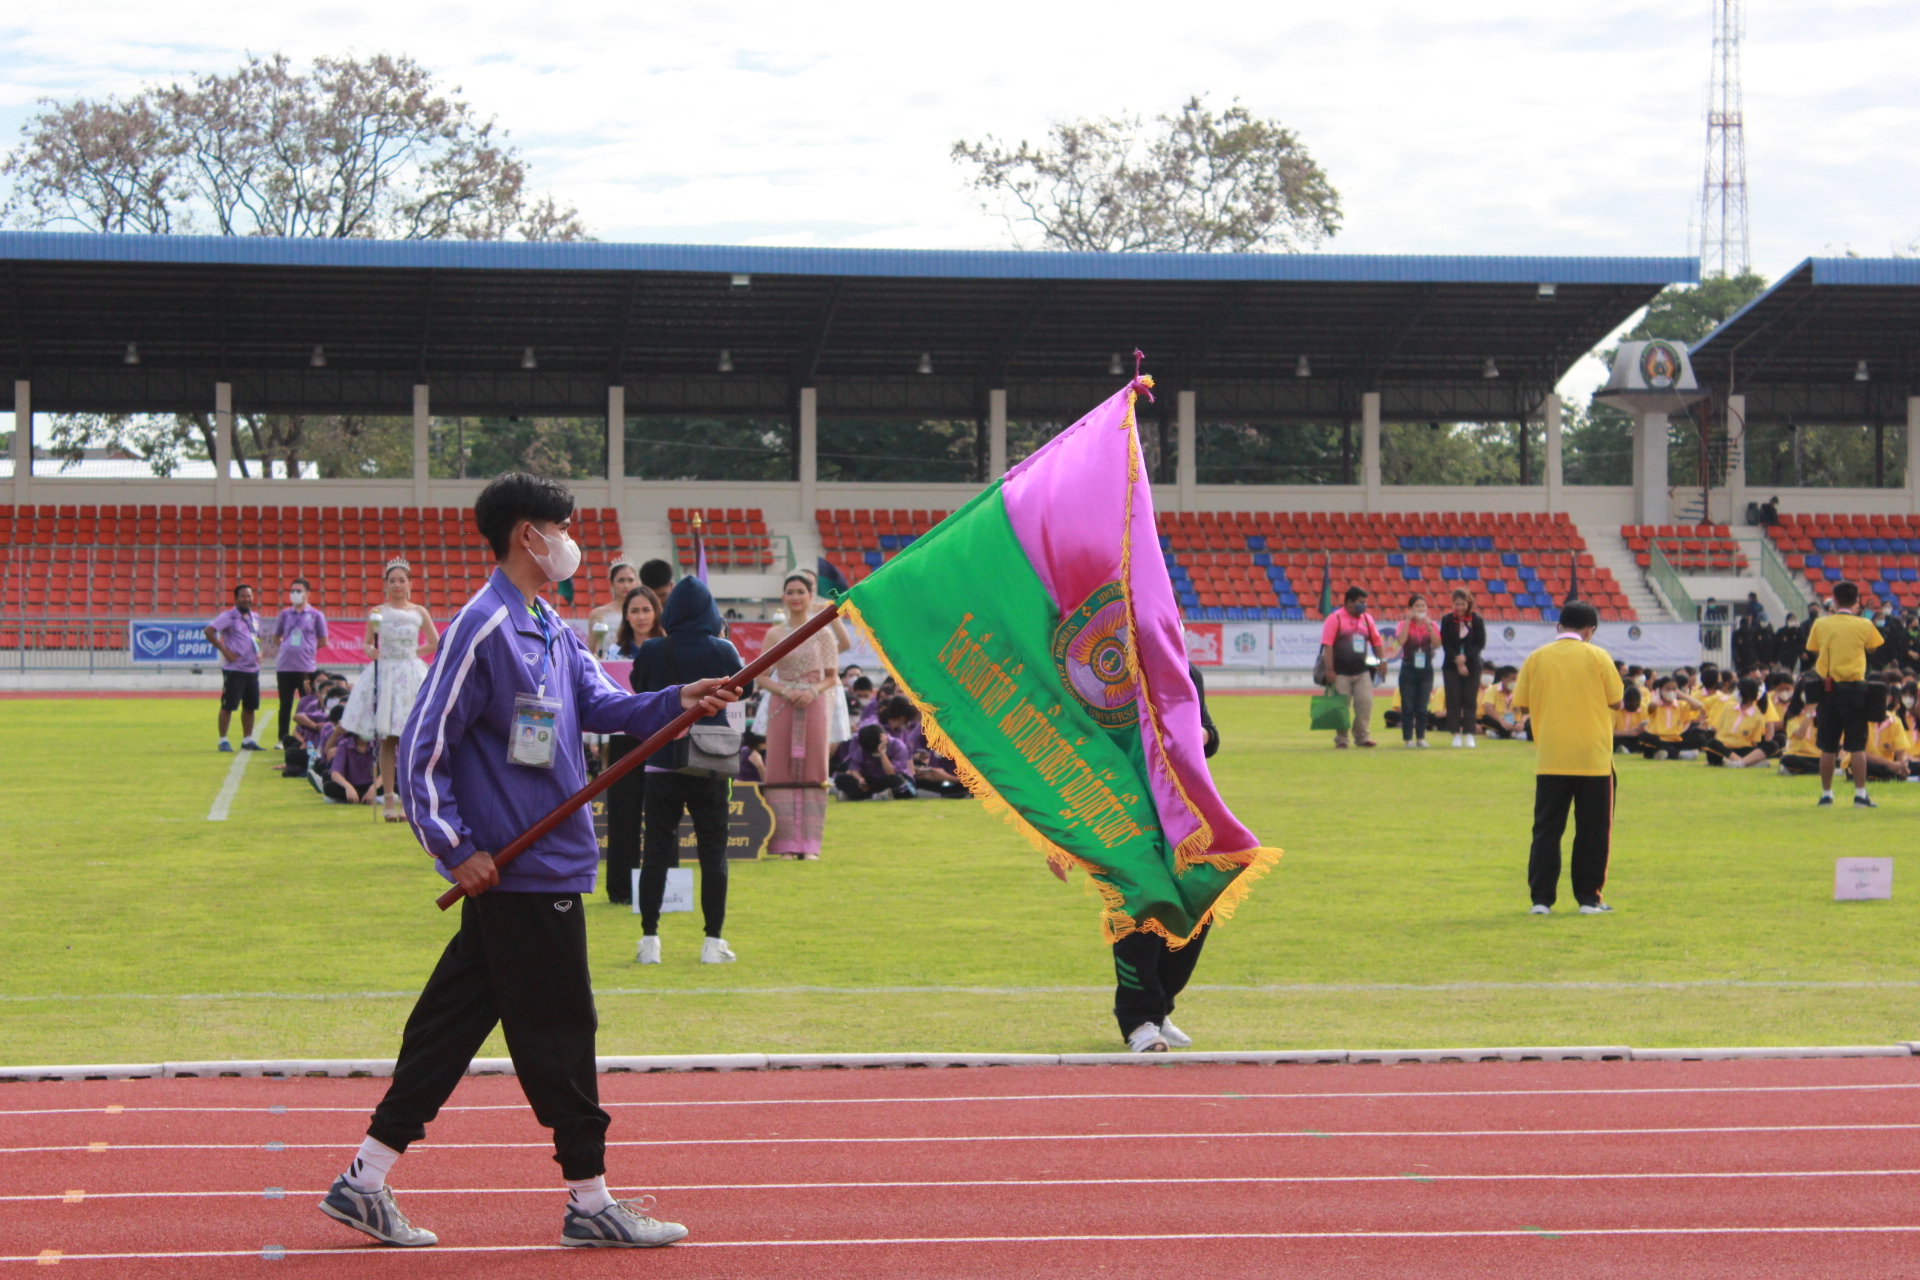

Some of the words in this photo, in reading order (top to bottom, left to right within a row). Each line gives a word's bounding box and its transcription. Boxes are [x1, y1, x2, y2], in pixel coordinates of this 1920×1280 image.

[177, 629, 207, 641] GRAN
[177, 643, 214, 656] SPORT
[1088, 705, 1139, 723] UNIVERSIT
[540, 732, 546, 740] F
[937, 612, 1024, 717] โรงเรียนสาธิต
[997, 704, 1159, 848] มหาวิทยาลัยราชภัฏสุรินทร์
